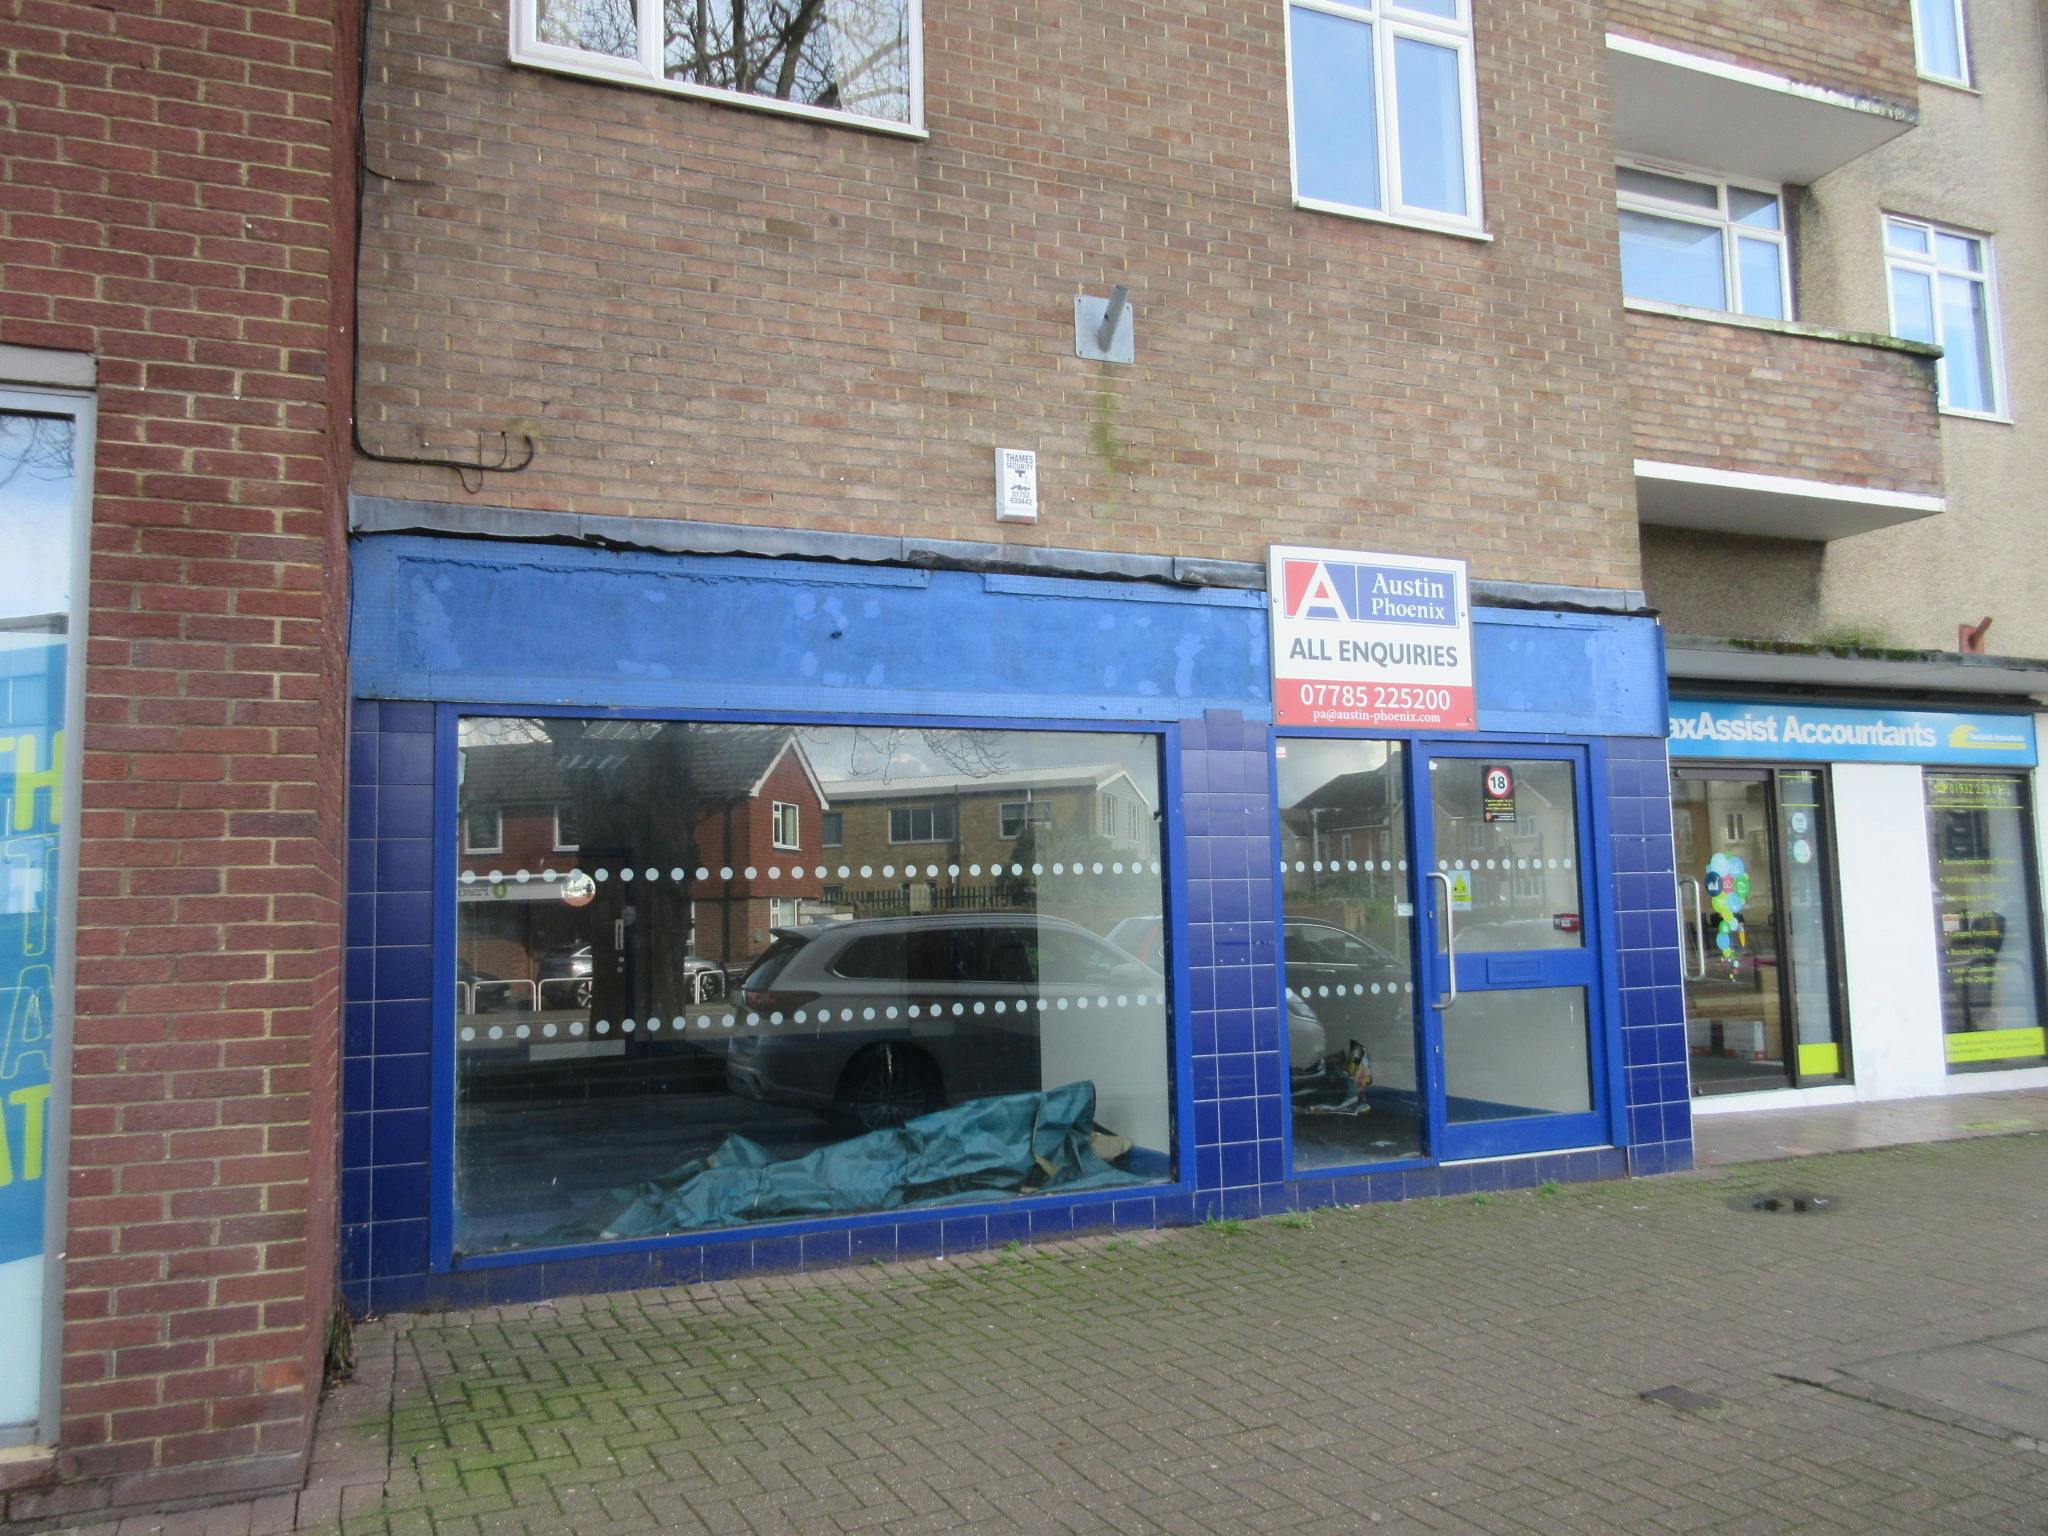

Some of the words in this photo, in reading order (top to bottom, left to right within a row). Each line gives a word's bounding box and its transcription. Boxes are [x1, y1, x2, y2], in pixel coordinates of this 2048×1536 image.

[1006, 453, 1033, 464] THAMES
[1007, 463, 1033, 471] SECURITY
[1371, 573, 1445, 598] Austin
[1371, 597, 1446, 620] Phoenix
[1289, 637, 1332, 661] ALL
[1338, 639, 1458, 668] ENQUIRIES
[1300, 683, 1368, 707] 07785
[1374, 686, 1450, 711] 225200
[1313, 708, 1441, 723] pa@austin-phoenix.com
[1669, 711, 1779, 743] axAssist
[1782, 715, 1937, 747] Accountants
[1490, 776, 1506, 789] 18
